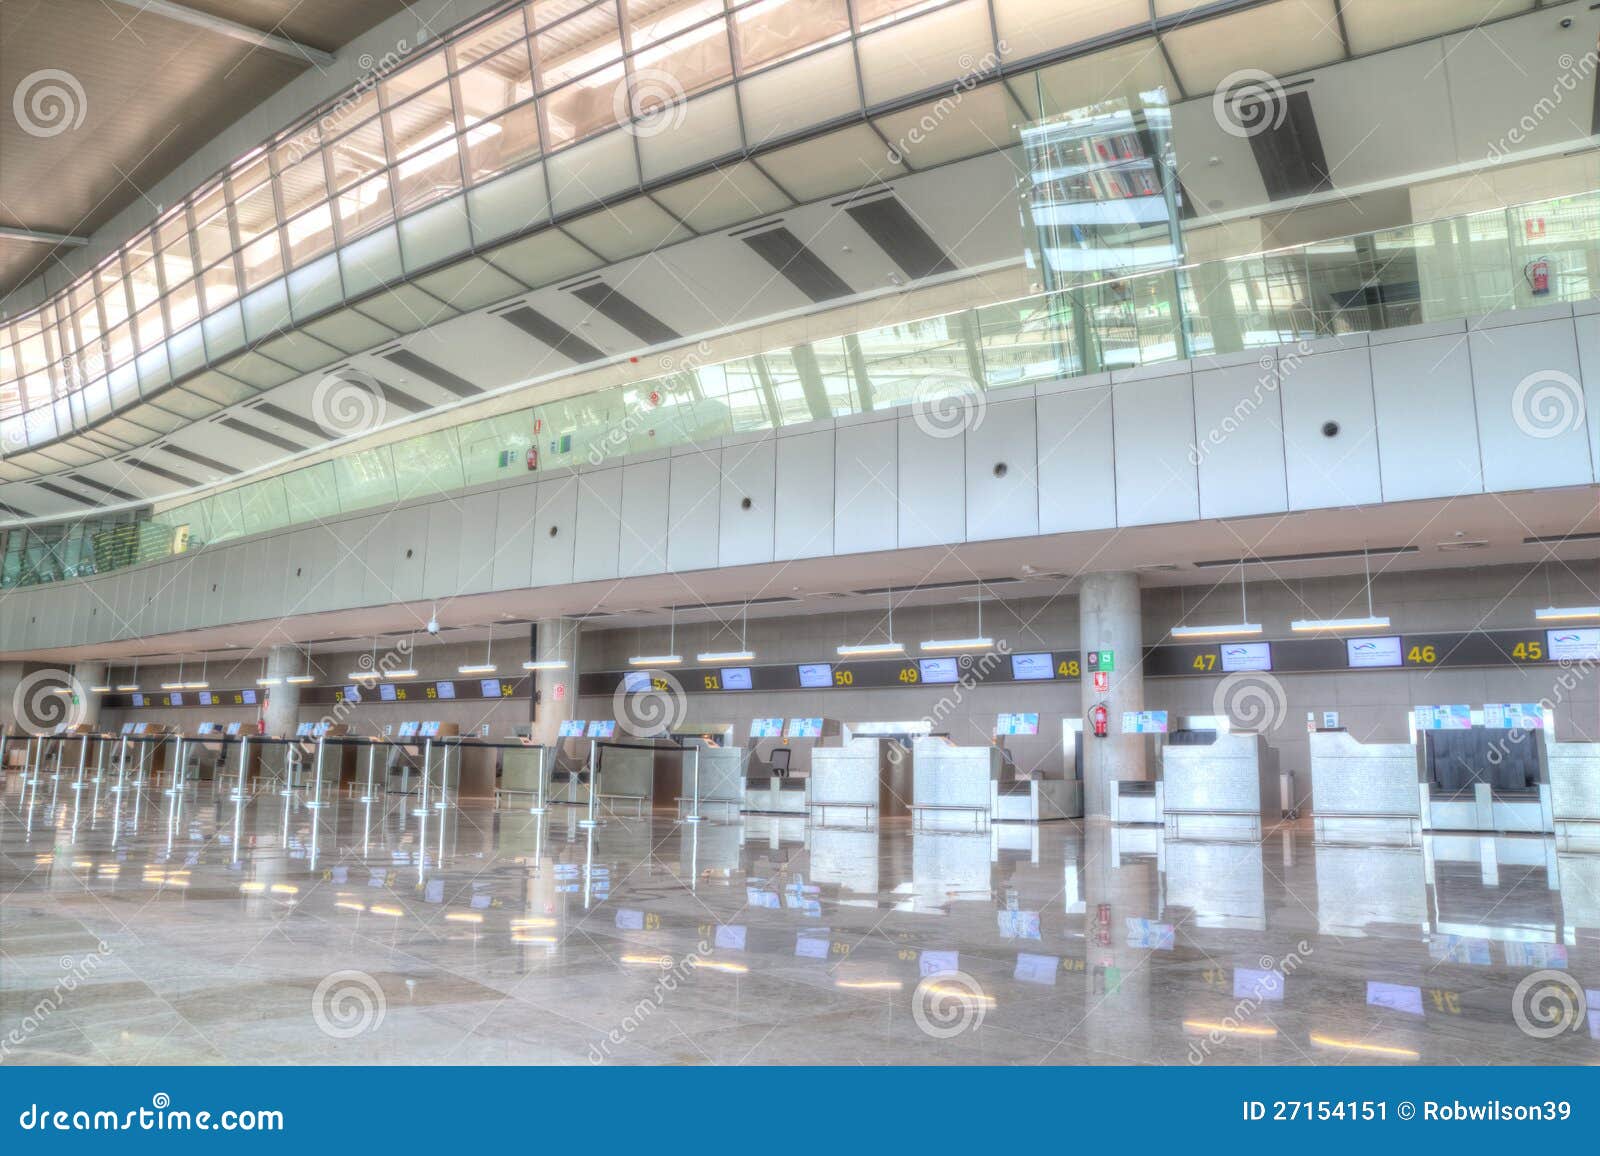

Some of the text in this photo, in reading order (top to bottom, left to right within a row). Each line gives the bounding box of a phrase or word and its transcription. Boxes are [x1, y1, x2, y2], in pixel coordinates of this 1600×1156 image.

[1407, 645, 1437, 664] 46
[1512, 641, 1542, 660] 45
[1058, 661, 1080, 677] 48
[1193, 654, 1217, 671] 47
[704, 676, 719, 689] 51
[835, 671, 854, 686] 50
[898, 668, 918, 684] 49
[501, 685, 513, 696] 54
[653, 678, 668, 691] 52
[426, 688, 436, 699] 55
